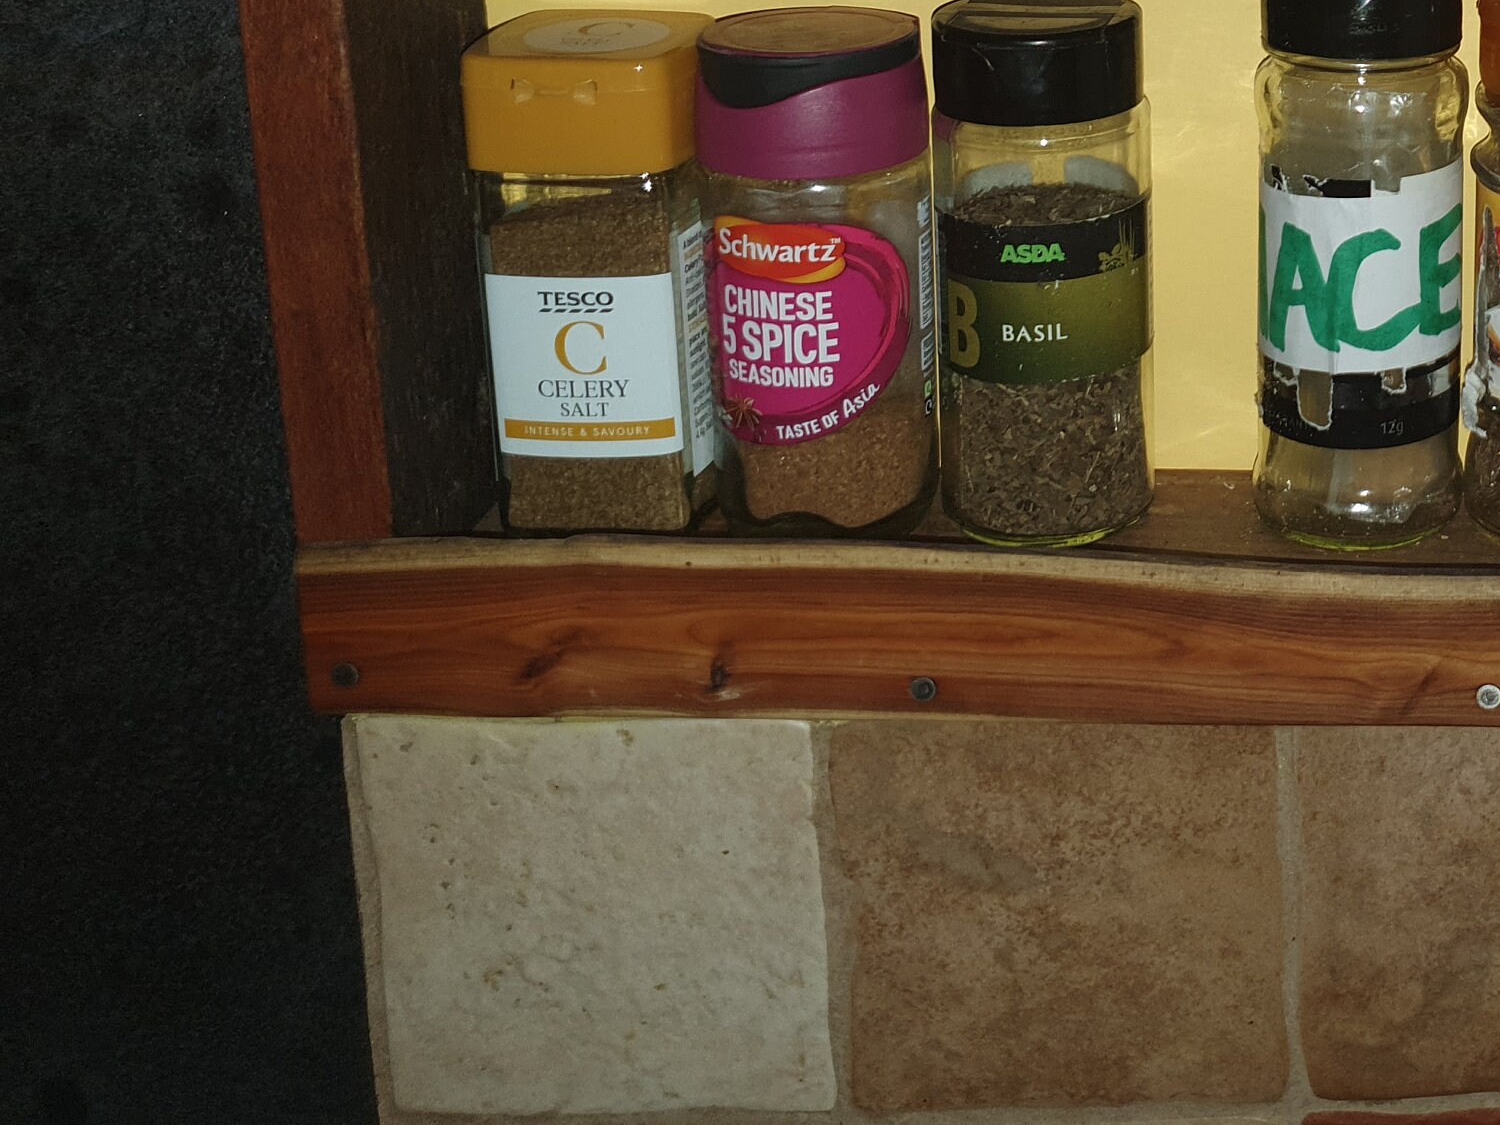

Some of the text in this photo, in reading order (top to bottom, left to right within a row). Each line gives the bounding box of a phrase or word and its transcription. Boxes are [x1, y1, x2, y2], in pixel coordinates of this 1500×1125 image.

[719, 228, 836, 262] Schwartz
[1001, 243, 1066, 264] ASDA
[1259, 203, 1462, 353] ACE
[538, 292, 614, 306] TESCO
[724, 285, 833, 321] CHINESE
[723, 314, 736, 354] 5
[742, 320, 840, 364] SPICE
[1002, 323, 1068, 343] BASIL
[555, 321, 607, 375] C
[729, 358, 834, 387] SEASONING
[538, 379, 630, 398] CELERY
[561, 402, 609, 417] SALT
[776, 382, 880, 439] TASTE OF Asia
[525, 426, 650, 436] INTENSE & SAVOURY
[1381, 420, 1404, 435] 12g
